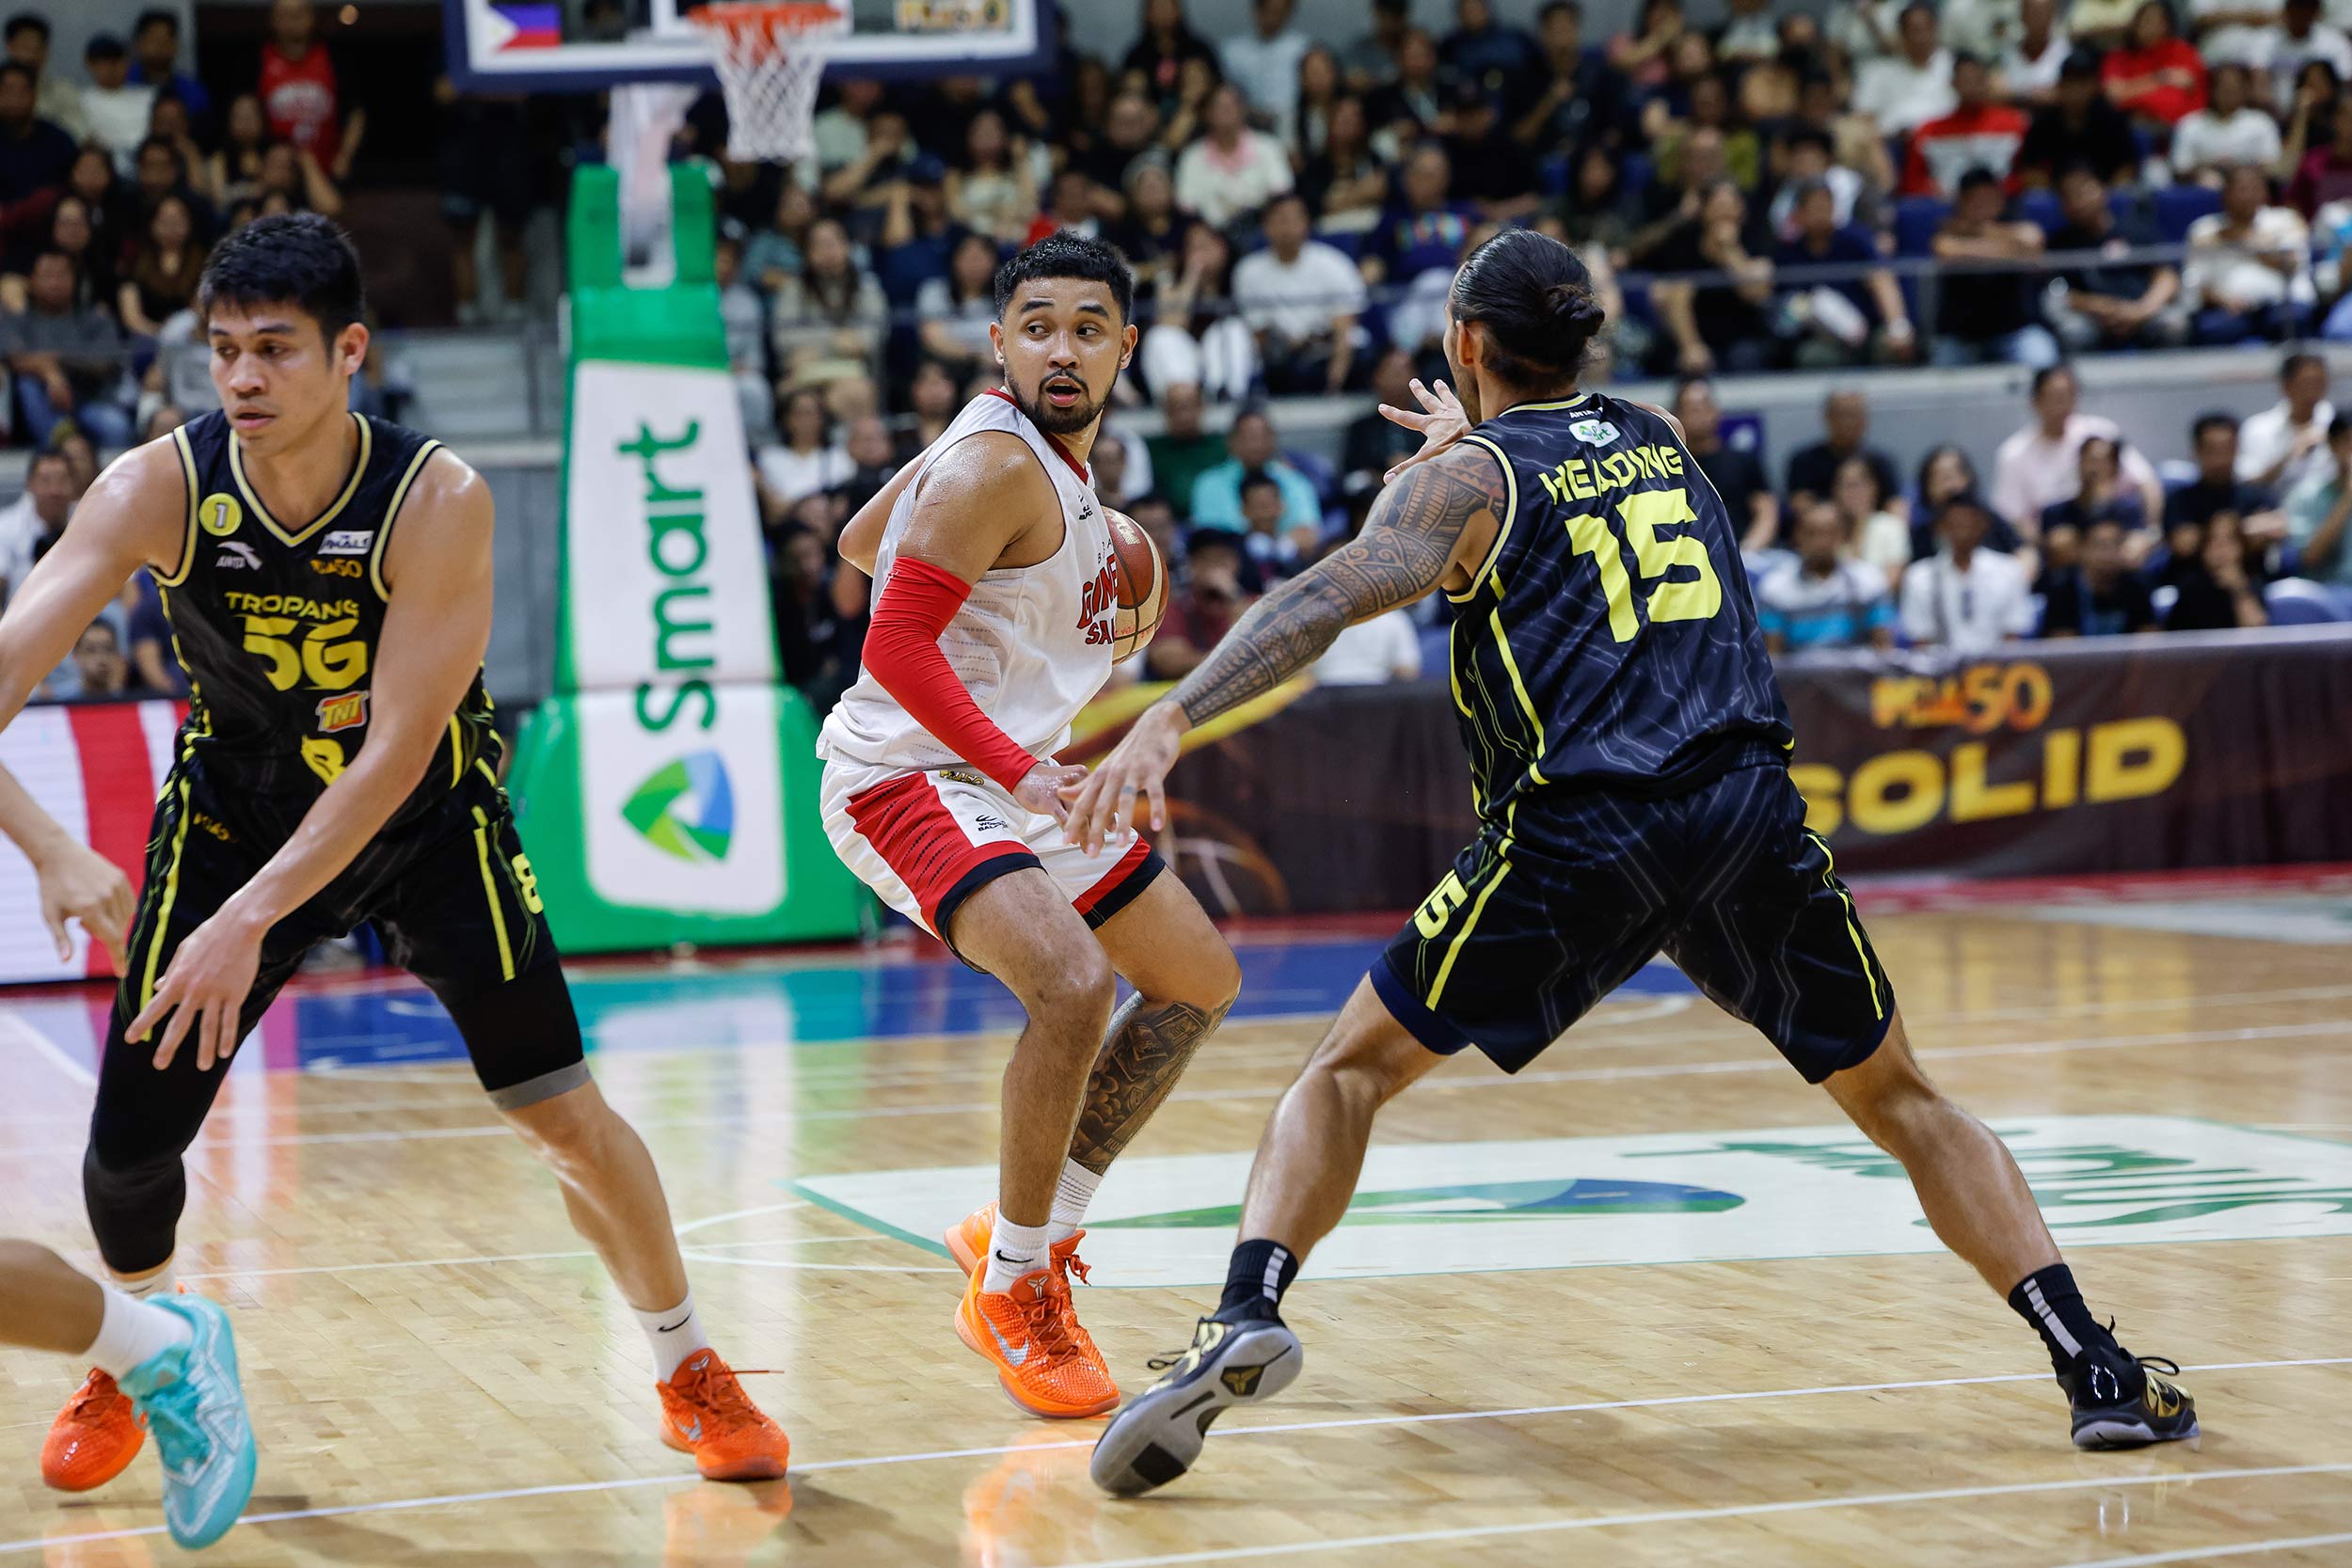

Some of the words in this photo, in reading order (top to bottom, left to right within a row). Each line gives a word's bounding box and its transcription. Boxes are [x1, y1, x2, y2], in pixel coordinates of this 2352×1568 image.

[1538, 443, 1684, 505] HEADING
[215, 503, 228, 529] 1
[617, 416, 718, 734] Smart
[1565, 488, 1723, 643] 15
[233, 613, 368, 691] 5G
[1085, 616, 1116, 645] SA
[320, 693, 368, 730] TNT
